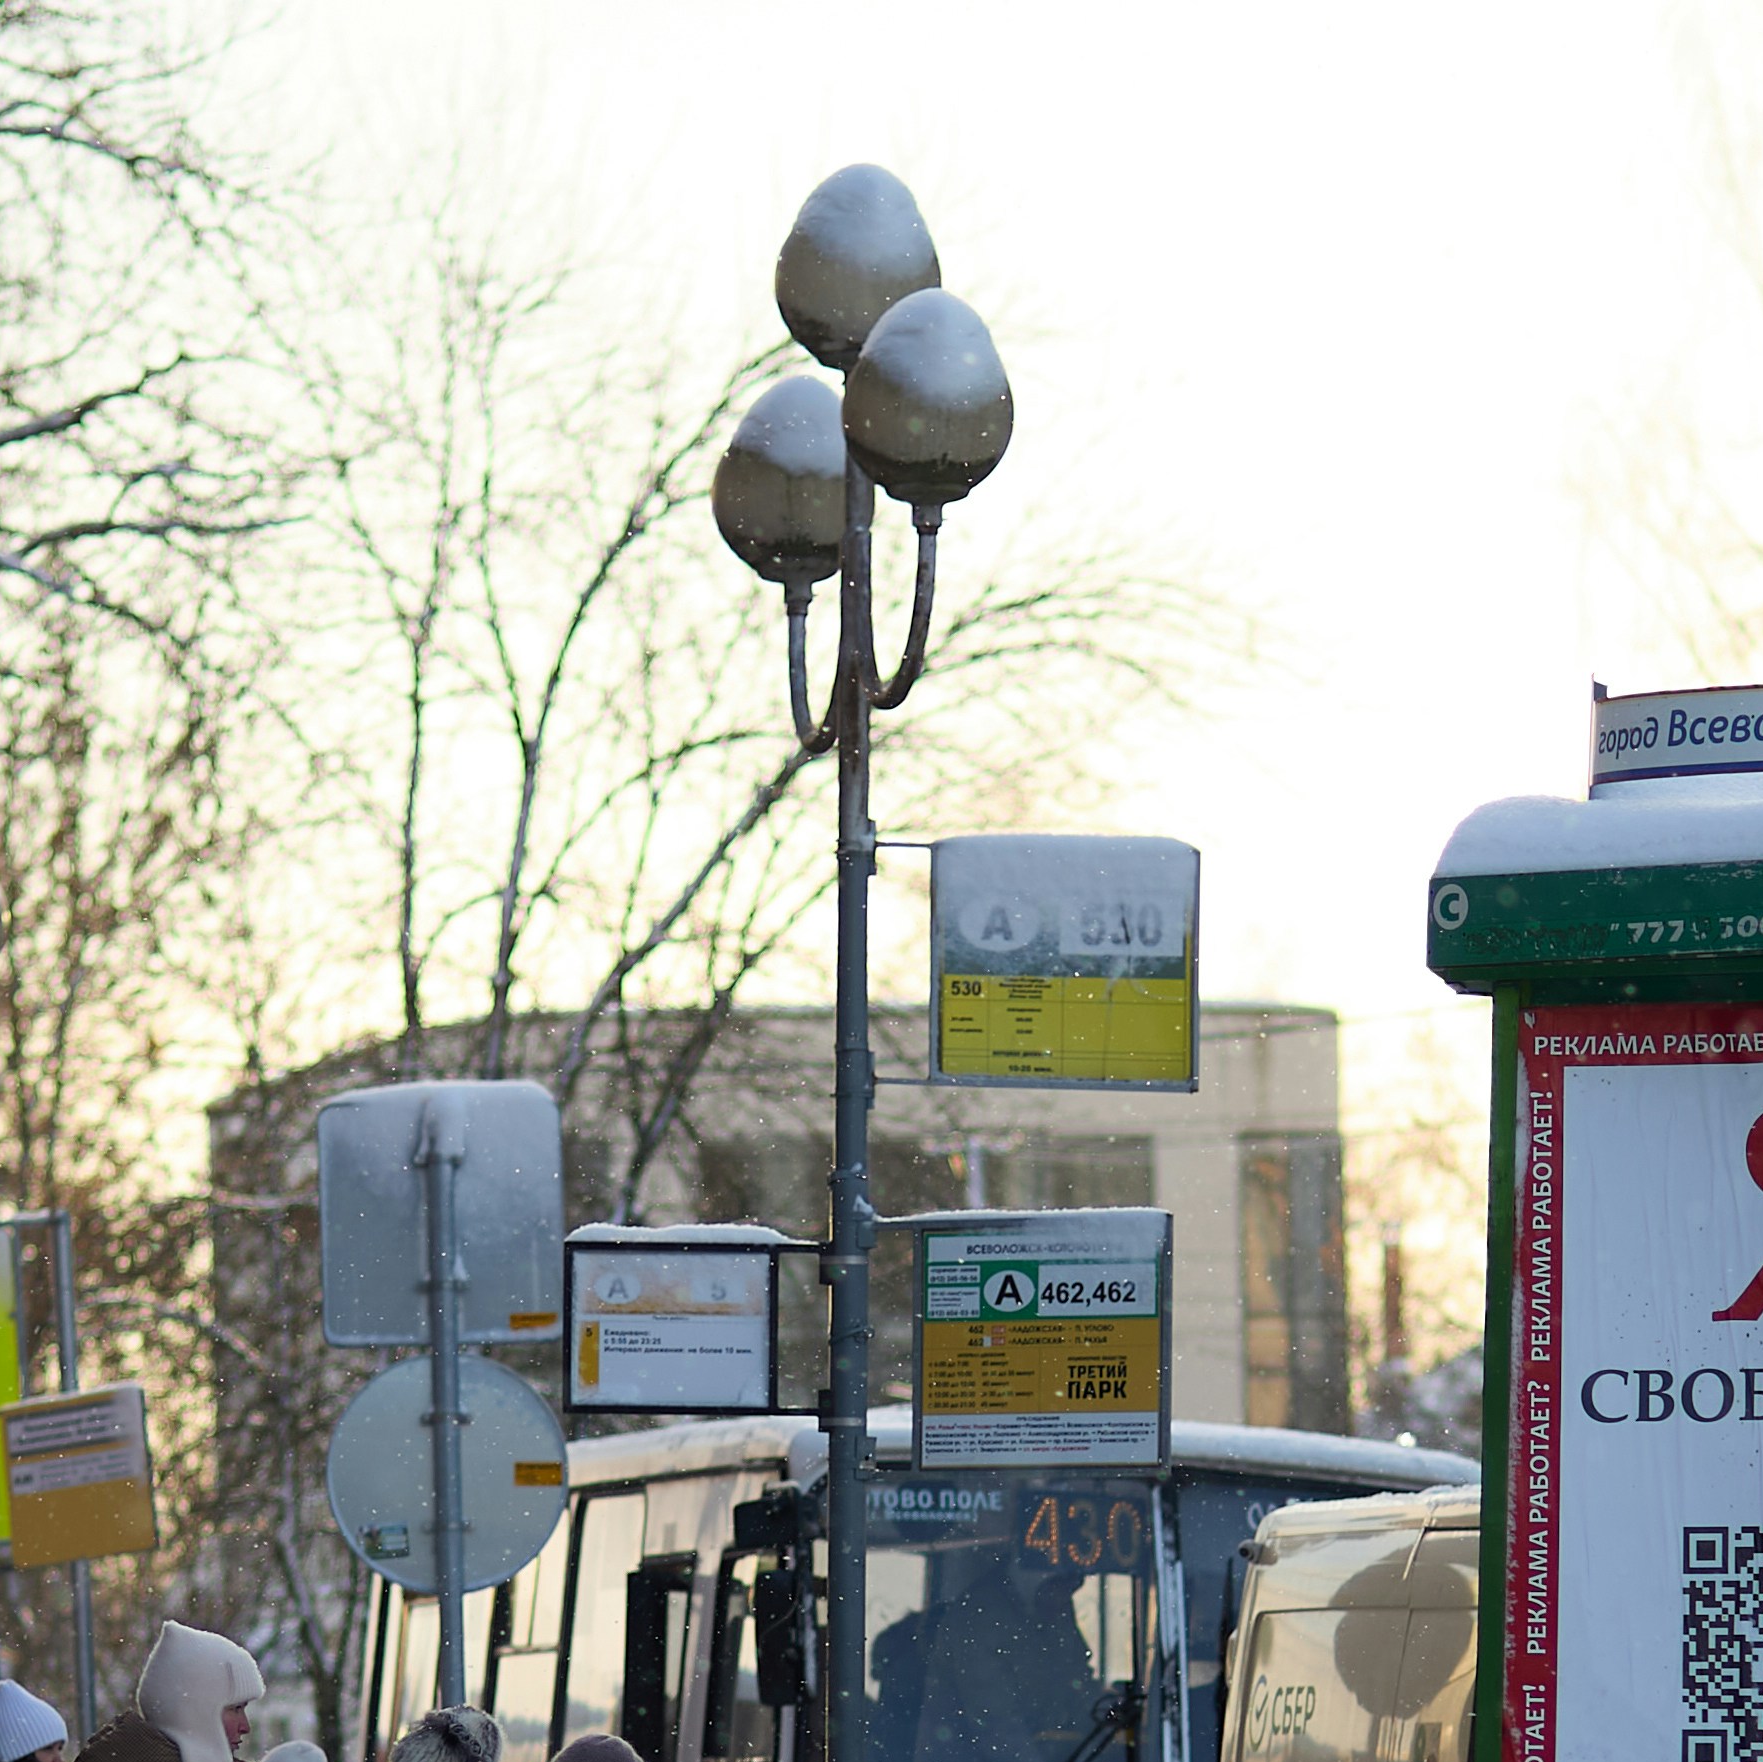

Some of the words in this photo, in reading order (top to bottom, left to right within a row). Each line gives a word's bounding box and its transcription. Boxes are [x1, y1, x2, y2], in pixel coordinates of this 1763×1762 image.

[1598, 715, 1659, 759] город
[951, 980, 982, 997] 530
[1534, 1035, 1657, 1056] РЕКЛАМА
[1530, 1091, 1553, 1231] РАБОТАЕТ!
[607, 1277, 629, 1299] А
[994, 1274, 1024, 1306] А
[1041, 1280, 1137, 1308] 462,462
[1530, 1236, 1552, 1362] РЕКЛАМА
[585, 1327, 594, 1338] 5
[968, 1325, 985, 1334] 462
[1067, 1362, 1127, 1379] ТРЕТИЙ
[1067, 1380, 1128, 1400] ПАРК
[1527, 1380, 1551, 1524] РАБОТАЕТ?
[865, 1489, 934, 1511] ТОВО
[939, 1488, 1004, 1511] ПОЛЕ
[1025, 1496, 1142, 1566] 430
[1526, 1530, 1549, 1655] РЕКЛАМА
[1272, 1686, 1316, 1736] СБЕР
